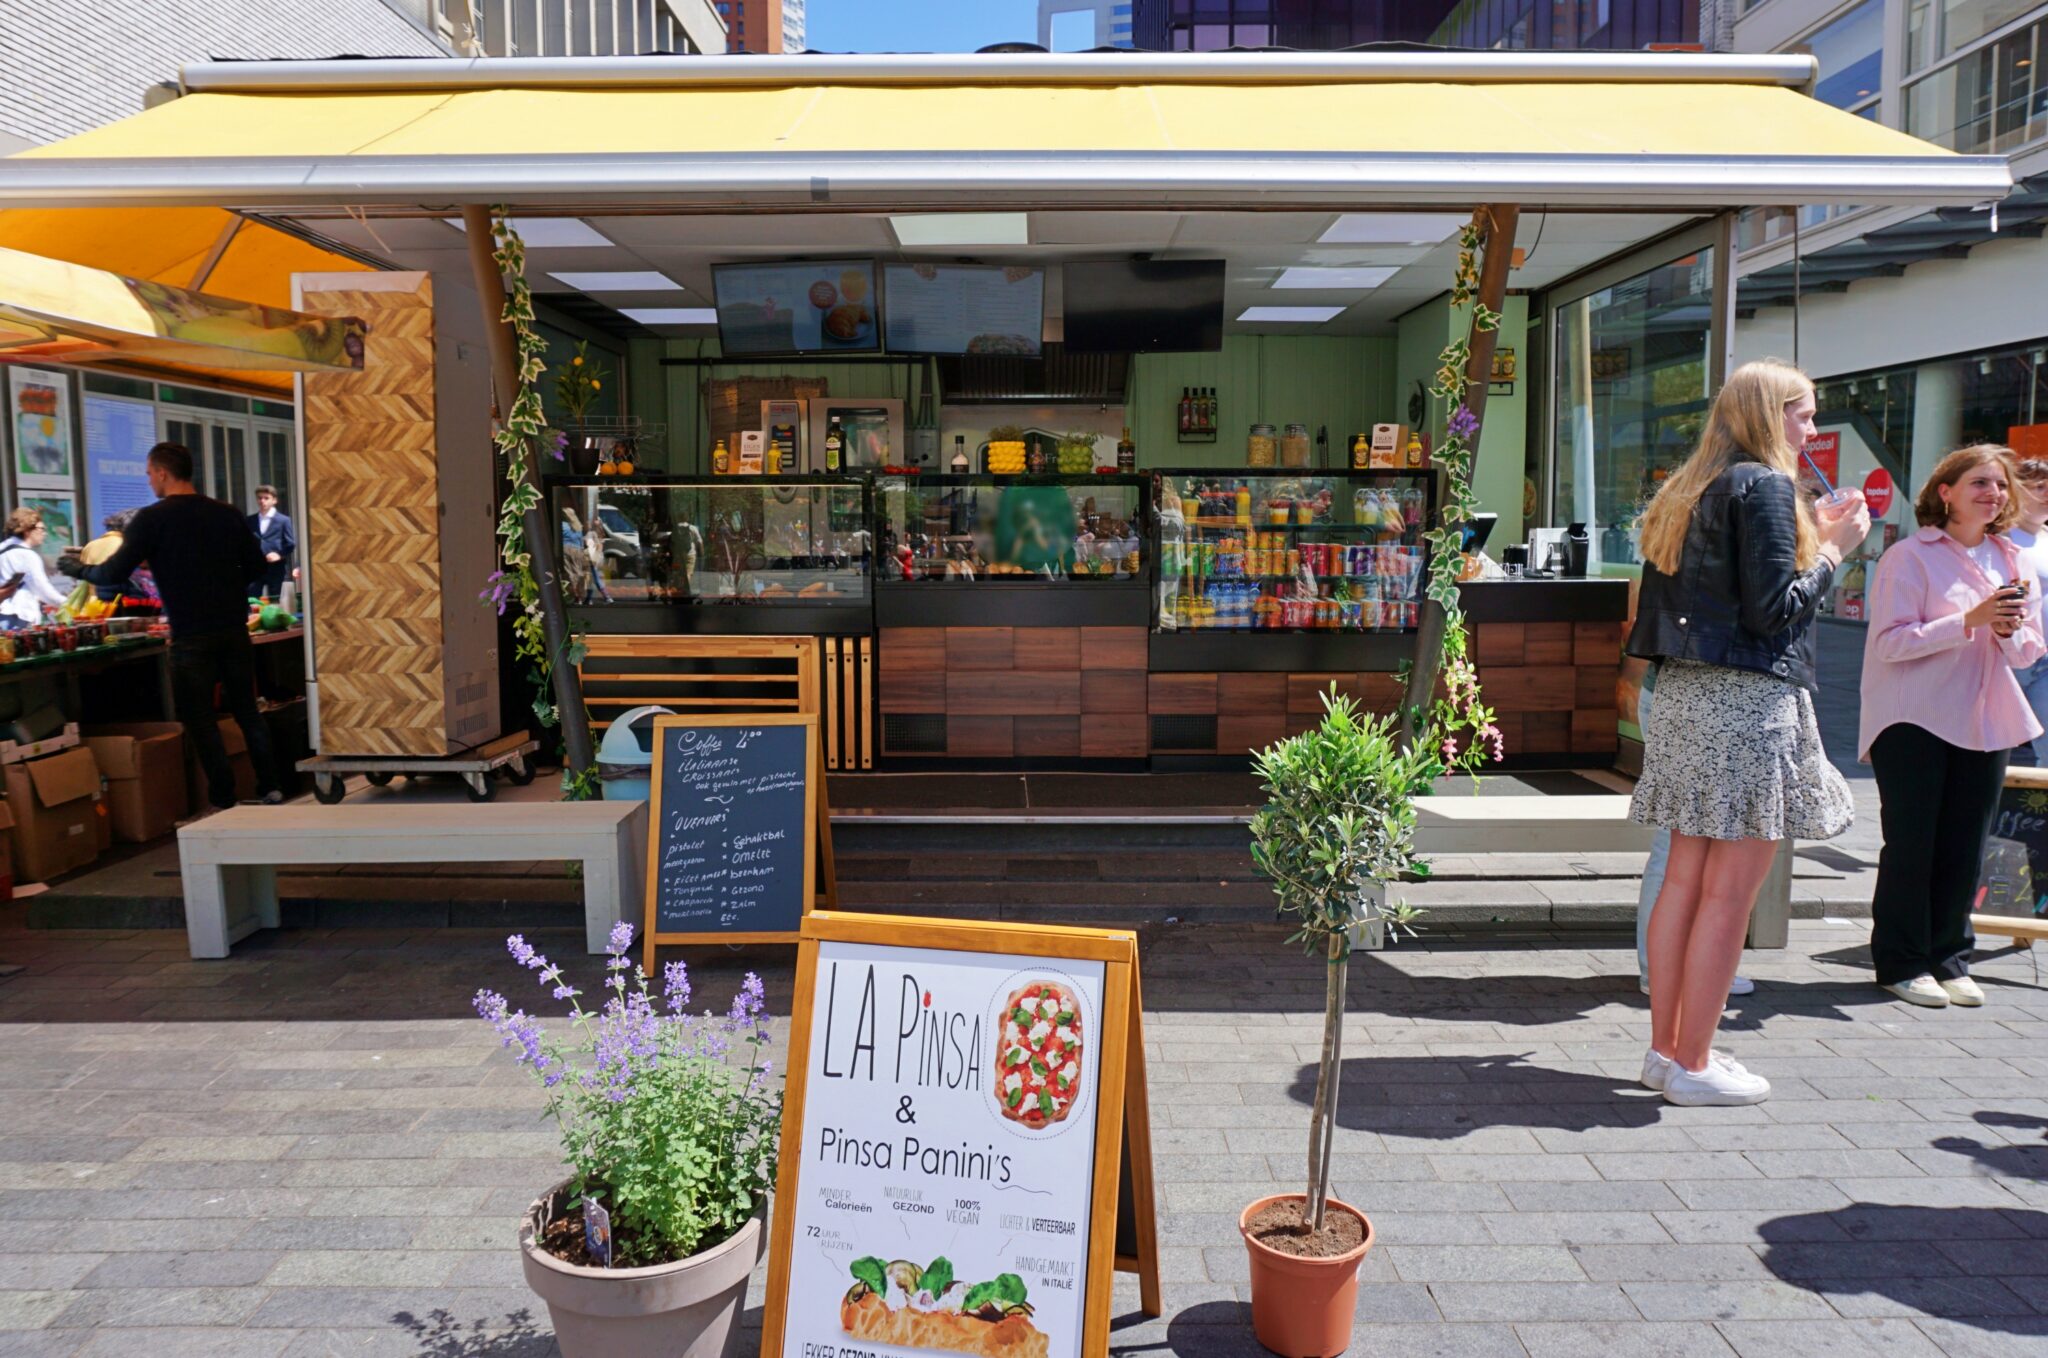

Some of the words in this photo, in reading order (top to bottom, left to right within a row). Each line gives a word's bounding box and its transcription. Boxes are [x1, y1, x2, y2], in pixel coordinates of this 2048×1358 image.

[1805, 437, 1834, 453] opdeal
[1866, 487, 1889, 496] topdeal
[678, 731, 722, 757] Coffee
[1995, 810, 2046, 838] ffee
[822, 961, 876, 1082] LA
[895, 1095, 917, 1124] &
[819, 1127, 893, 1170] Pinsa
[902, 1136, 1012, 1183] Panini's
[819, 1186, 852, 1201] MINDER
[883, 1186, 924, 1202] NATUURLIJK
[825, 1198, 873, 1213] Calorieën
[892, 1201, 935, 1215] GEZOND
[954, 1198, 981, 1211] 100%
[945, 1209, 981, 1226] VEGAN
[999, 1213, 1024, 1231] LICHTER
[1031, 1218, 1076, 1236] VERTEERBAAR
[806, 1225, 821, 1238] 72
[821, 1229, 841, 1240] UUR
[820, 1239, 854, 1252] RIJZEN
[1015, 1256, 1076, 1278] HANDGEMAAKT
[1042, 1277, 1050, 1288] IN
[1051, 1278, 1074, 1290] ITALIË
